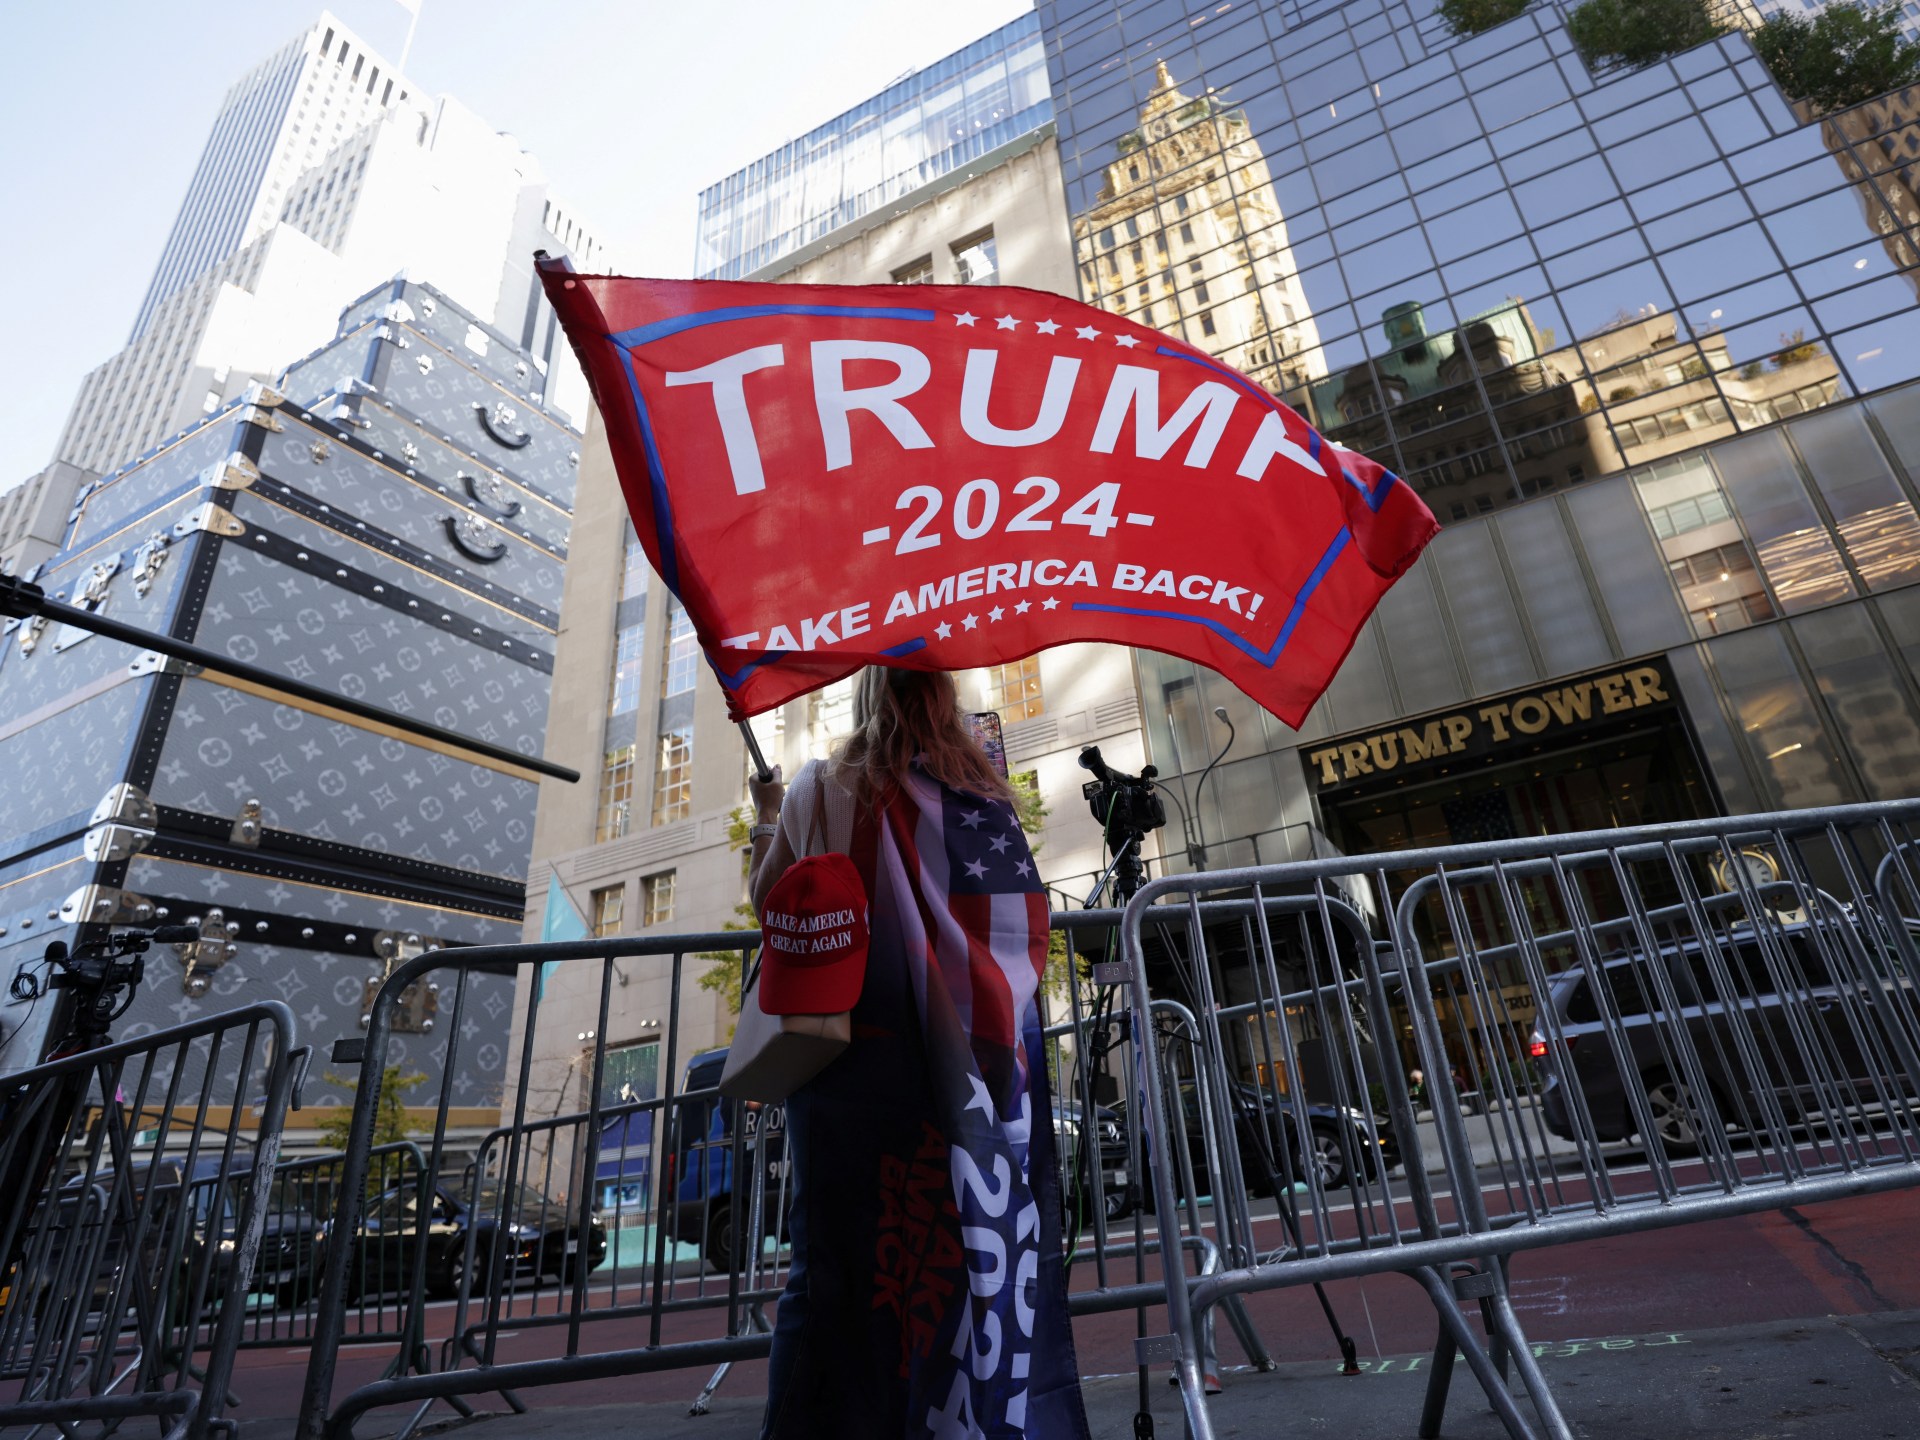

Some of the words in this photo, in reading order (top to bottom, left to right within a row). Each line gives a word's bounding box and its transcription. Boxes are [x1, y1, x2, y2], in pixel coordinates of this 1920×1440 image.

[862, 475, 1154, 556] -2024-
[882, 558, 1099, 626] AMERICA
[1111, 563, 1265, 621] BACK!
[1311, 716, 1472, 785] TRUMP
[1479, 666, 1669, 743] TOWER
[766, 910, 797, 932] MAKE
[798, 908, 855, 933] AMERICA
[770, 933, 807, 954] GREAT
[810, 931, 852, 954] AGAIN
[1496, 993, 1535, 1010] RU
[926, 1144, 1011, 1440] 2024
